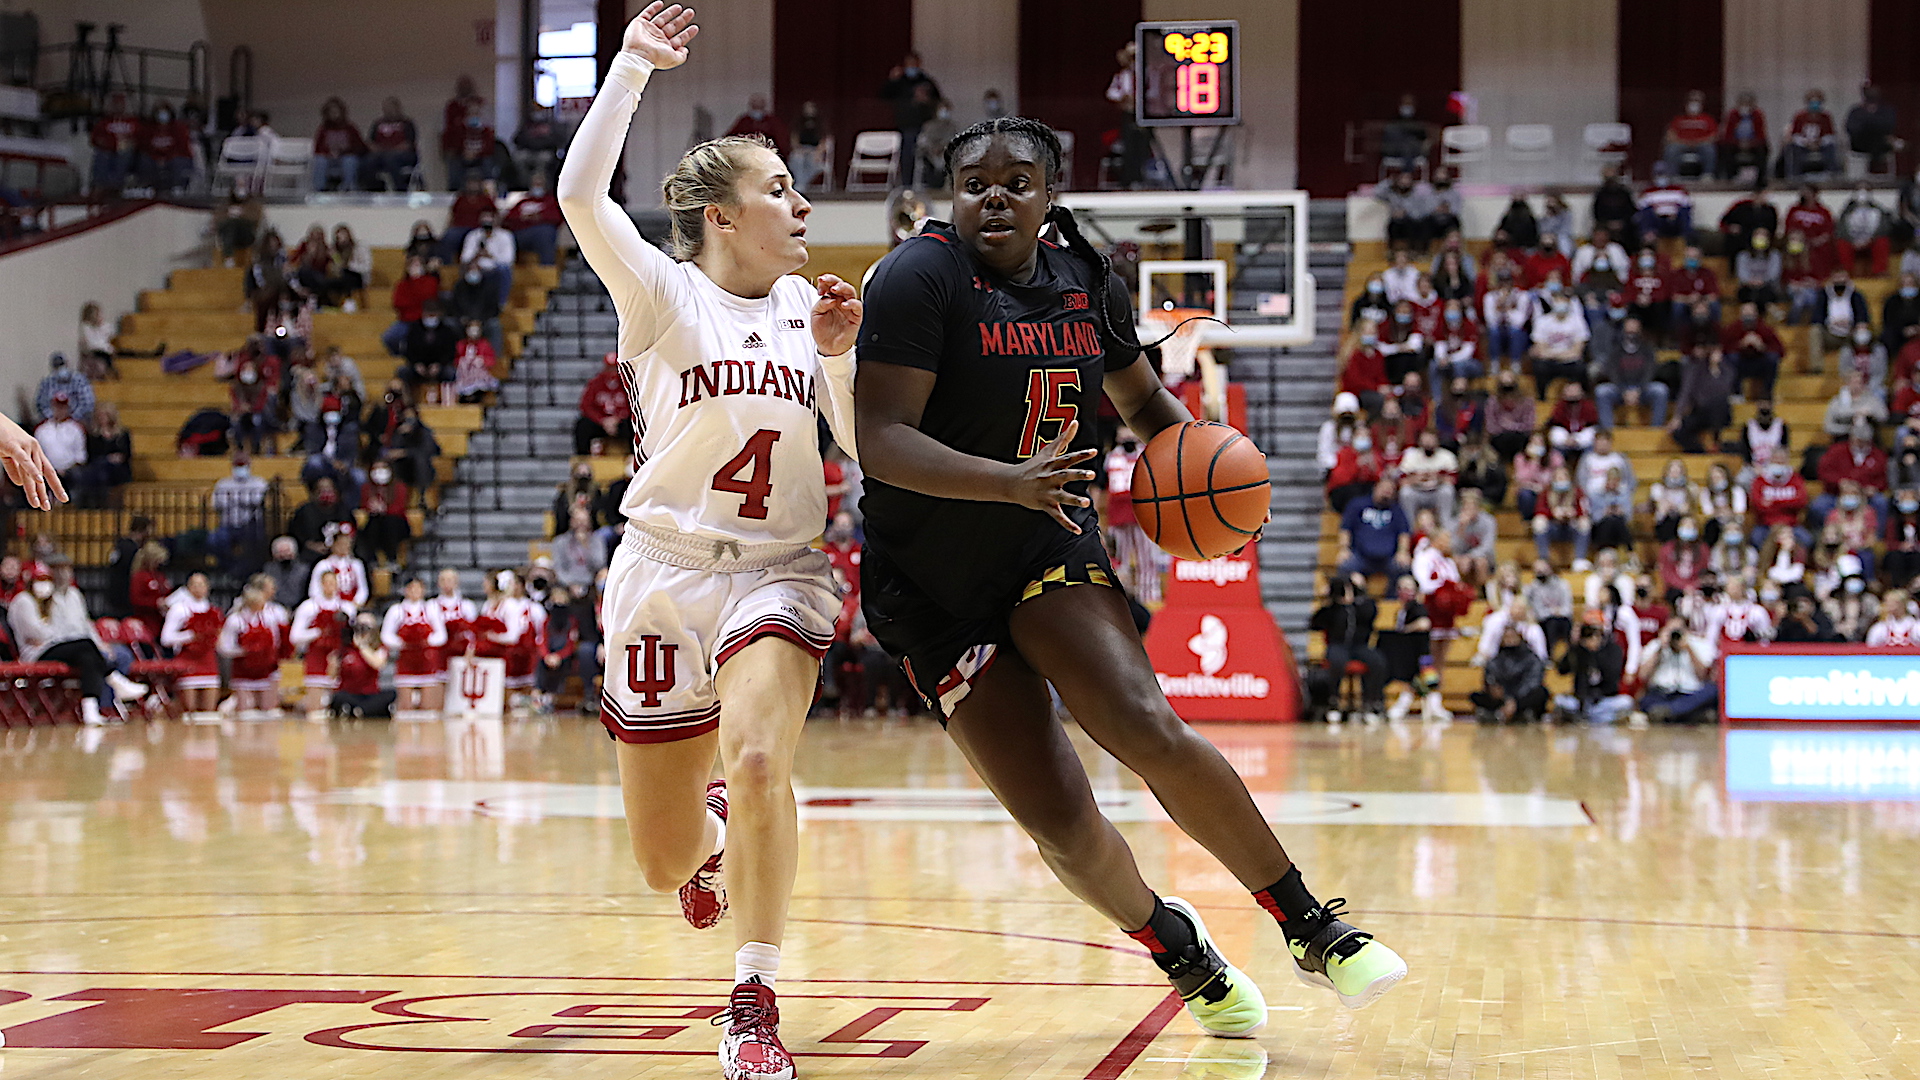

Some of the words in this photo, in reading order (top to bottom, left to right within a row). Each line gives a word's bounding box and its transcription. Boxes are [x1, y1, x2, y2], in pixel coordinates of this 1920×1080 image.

[1164, 32, 1228, 63] 9:23
[1176, 62, 1220, 114] 18
[978, 321, 1102, 356] MARYLAND
[678, 360, 816, 418] INDIANA
[1017, 368, 1081, 458] 15
[711, 428, 782, 520] 4
[1176, 558, 1252, 586] meijer
[1769, 669, 1920, 706] smithvi
